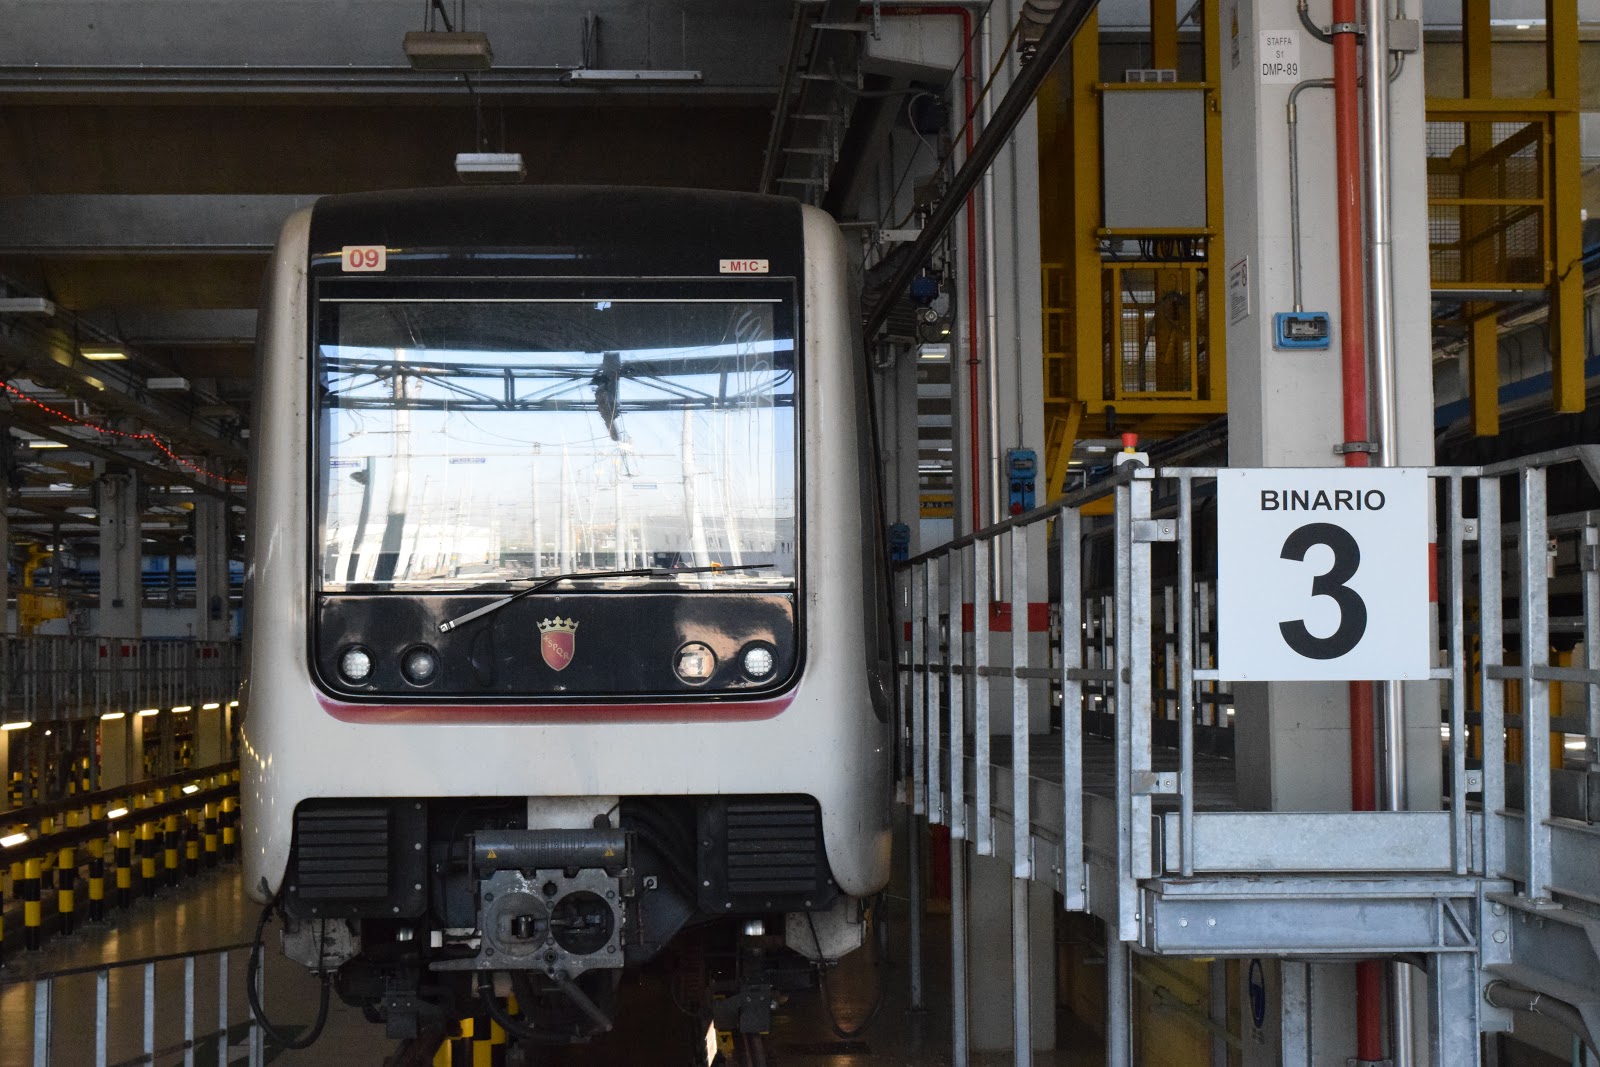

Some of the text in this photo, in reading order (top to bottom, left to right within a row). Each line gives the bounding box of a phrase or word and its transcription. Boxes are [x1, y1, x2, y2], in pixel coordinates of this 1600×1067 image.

[1266, 37, 1292, 46] STAFFA
[1275, 50, 1284, 59] S1
[1262, 63, 1298, 76] DMP-89
[349, 248, 379, 268] 09
[1260, 489, 1386, 511] BINARIO
[1278, 522, 1368, 660] 3
[547, 639, 570, 660] SPQR
